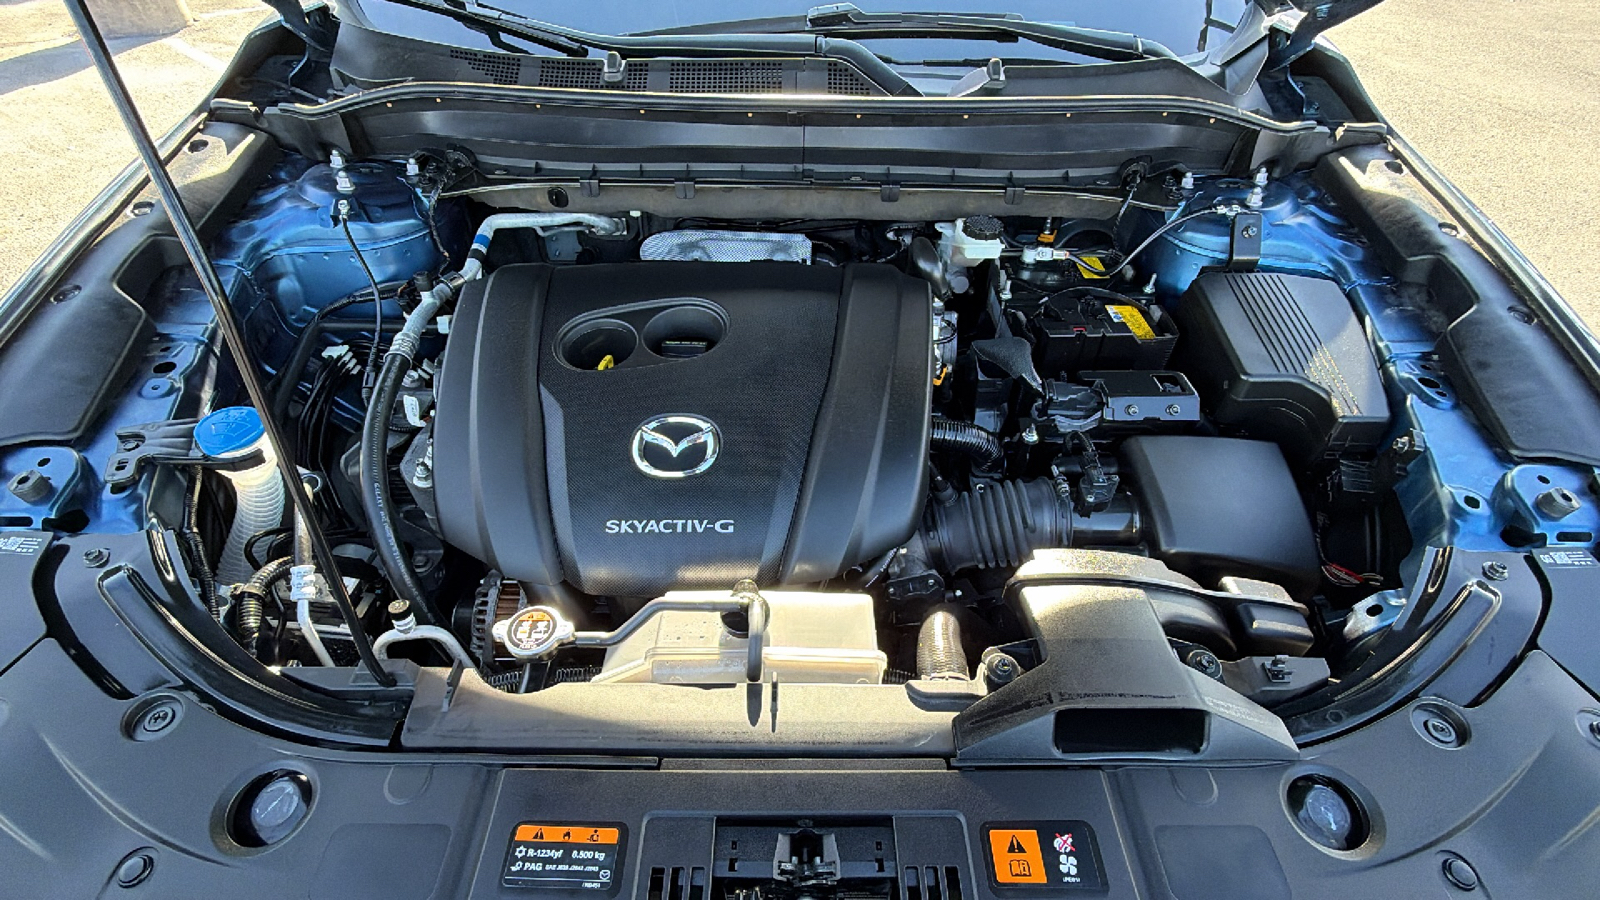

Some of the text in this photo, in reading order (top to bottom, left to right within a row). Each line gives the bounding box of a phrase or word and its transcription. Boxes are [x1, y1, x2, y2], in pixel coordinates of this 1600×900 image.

[605, 519, 735, 534] SKYACTIV-G
[527, 849, 564, 859] R-1234yf
[594, 851, 606, 861] kg
[523, 862, 543, 871] PAG
